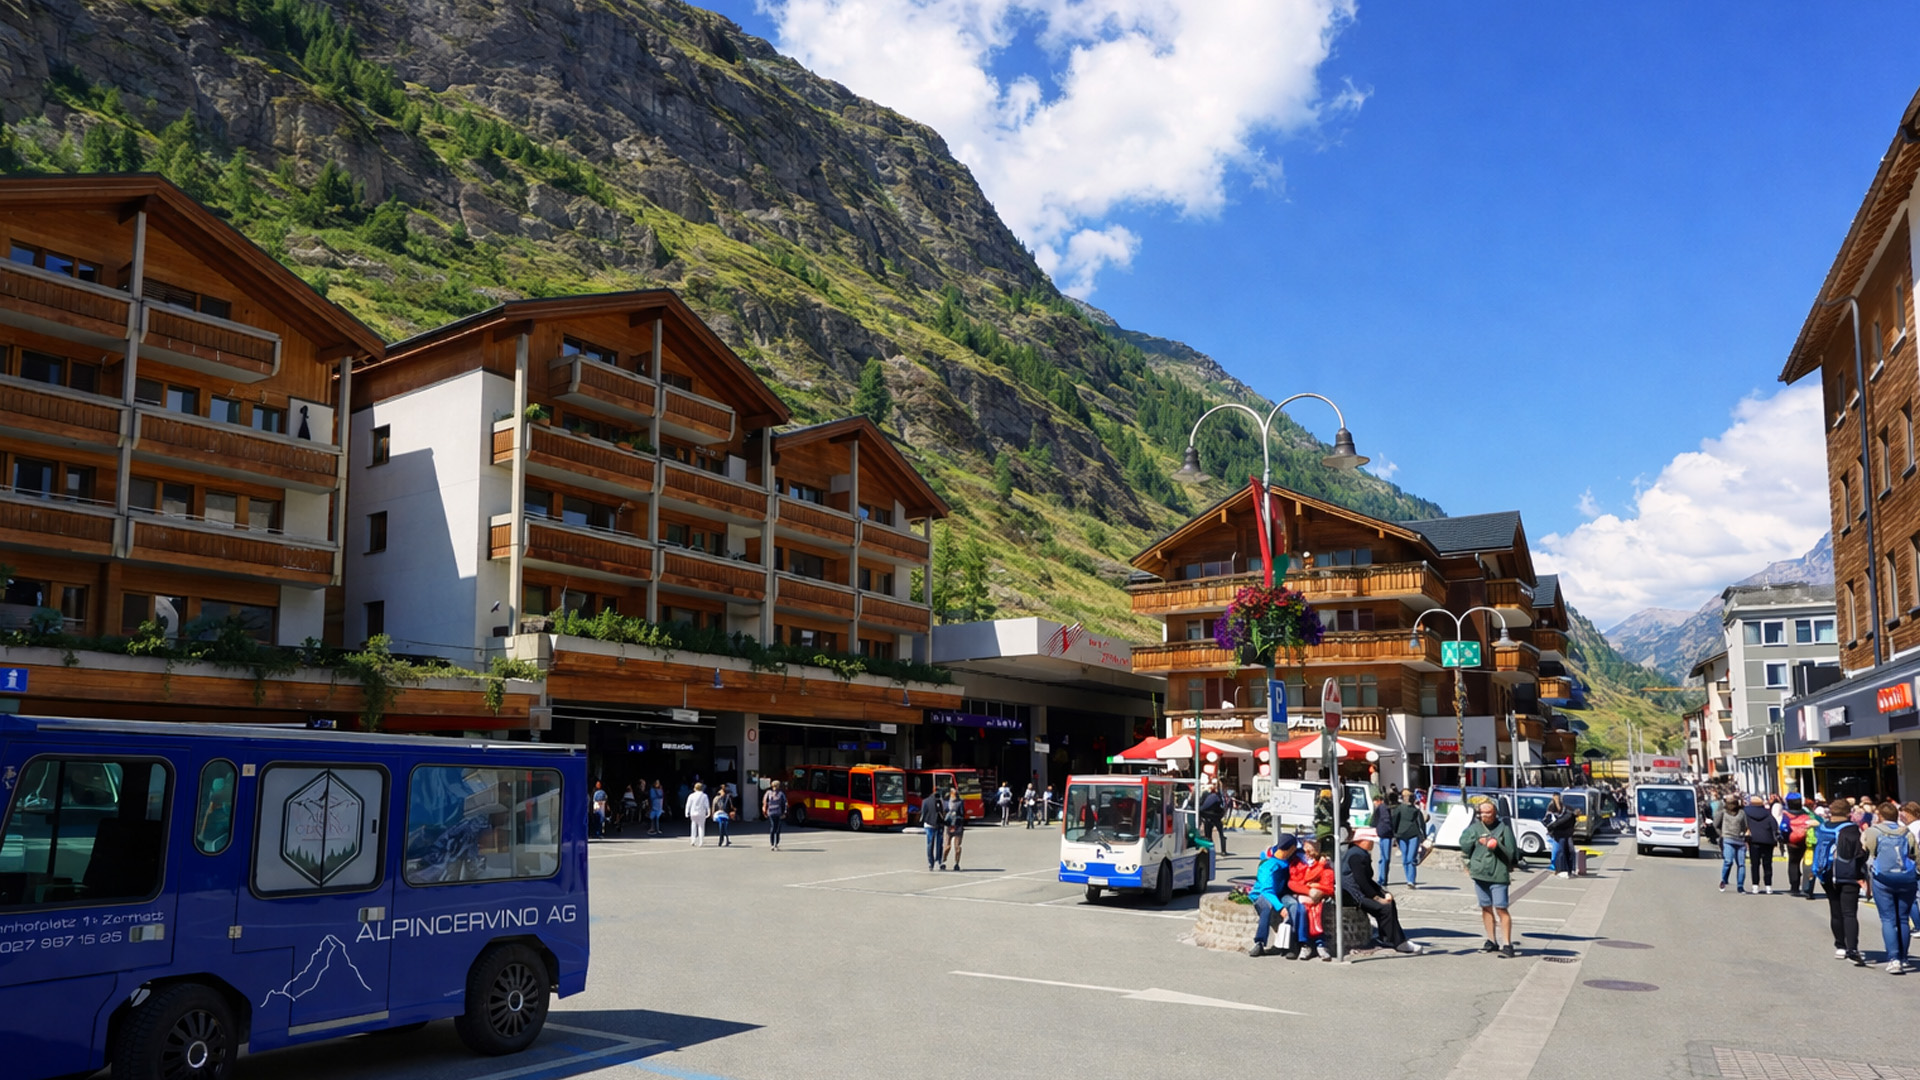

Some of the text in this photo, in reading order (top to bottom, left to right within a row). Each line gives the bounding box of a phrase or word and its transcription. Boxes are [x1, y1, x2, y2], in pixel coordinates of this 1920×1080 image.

[1276, 687, 1283, 713] P
[355, 904, 577, 943] ALPINCERVINO AG
[41, 935, 74, 949] 967
